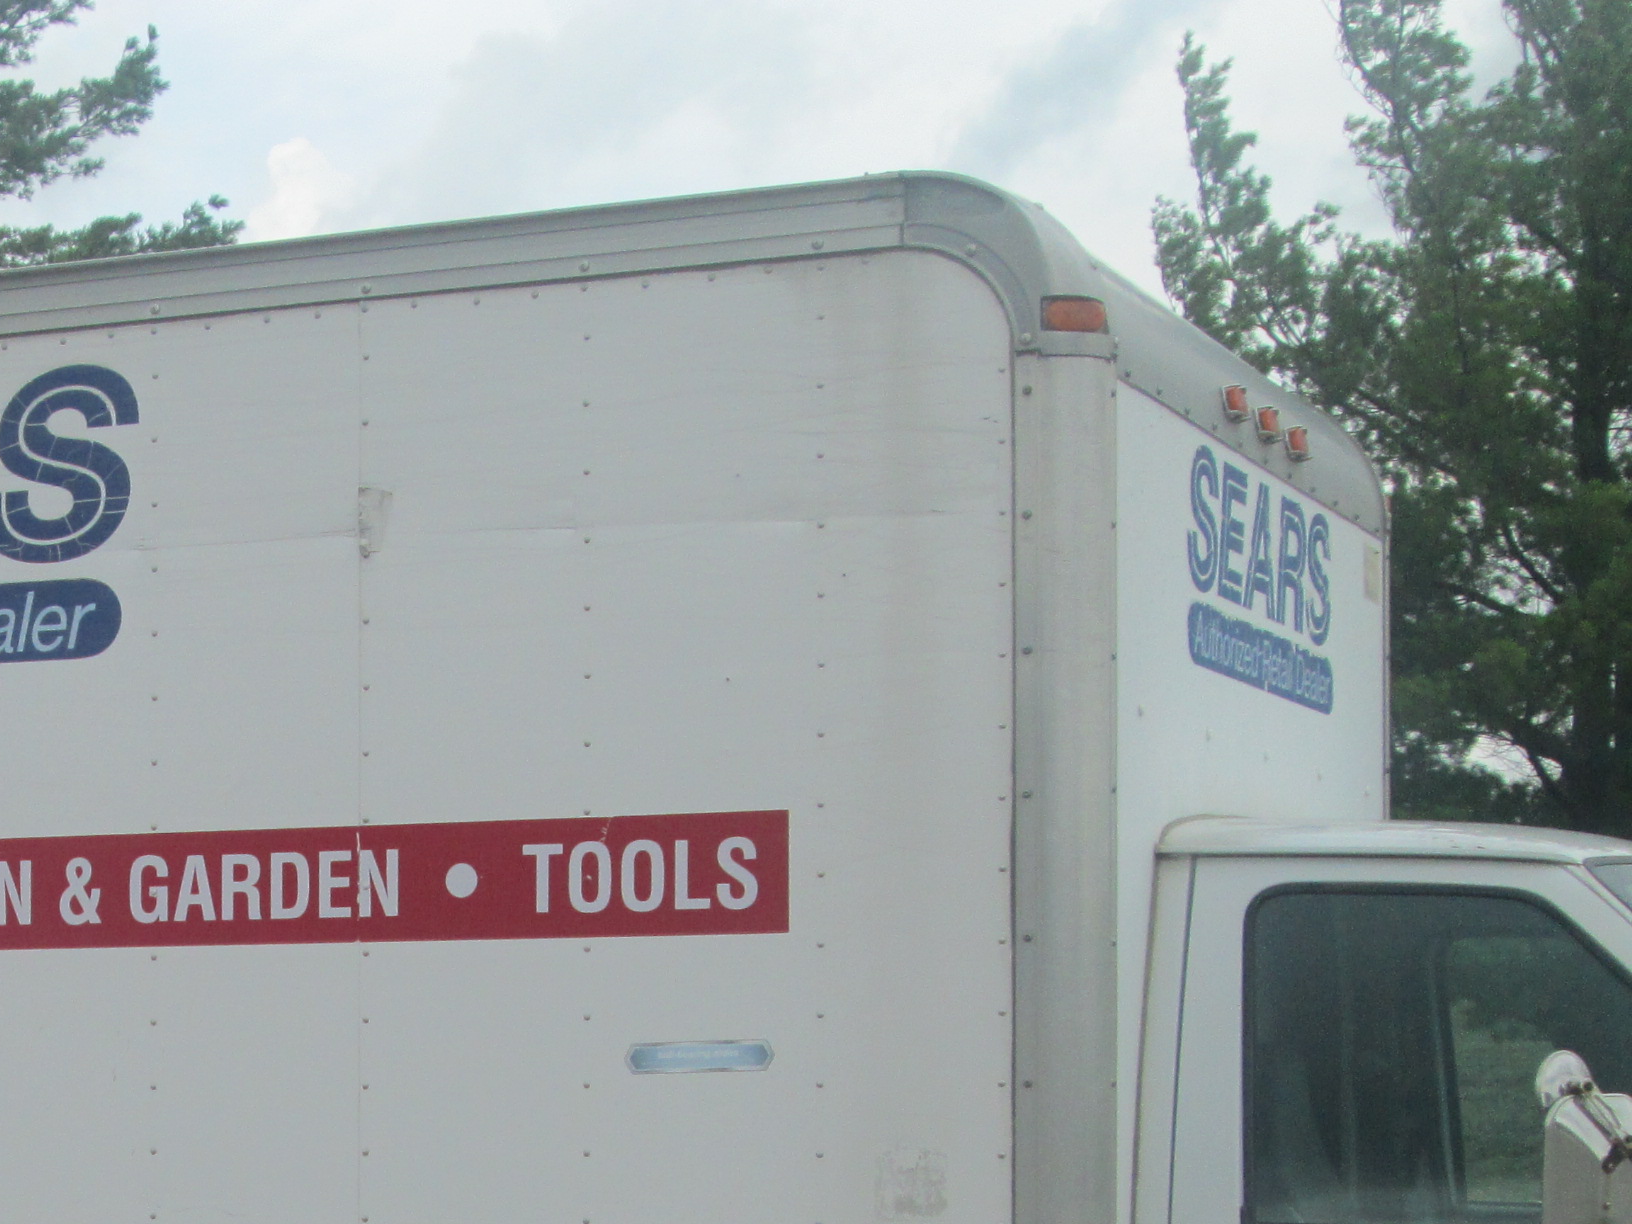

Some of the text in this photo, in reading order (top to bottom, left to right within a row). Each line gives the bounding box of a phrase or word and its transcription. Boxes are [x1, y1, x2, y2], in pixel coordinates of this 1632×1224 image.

[1187, 445, 1331, 646] SEARS
[60, 857, 102, 926] &
[129, 849, 399, 924] GARDEN
[523, 837, 758, 913] TOOLS
